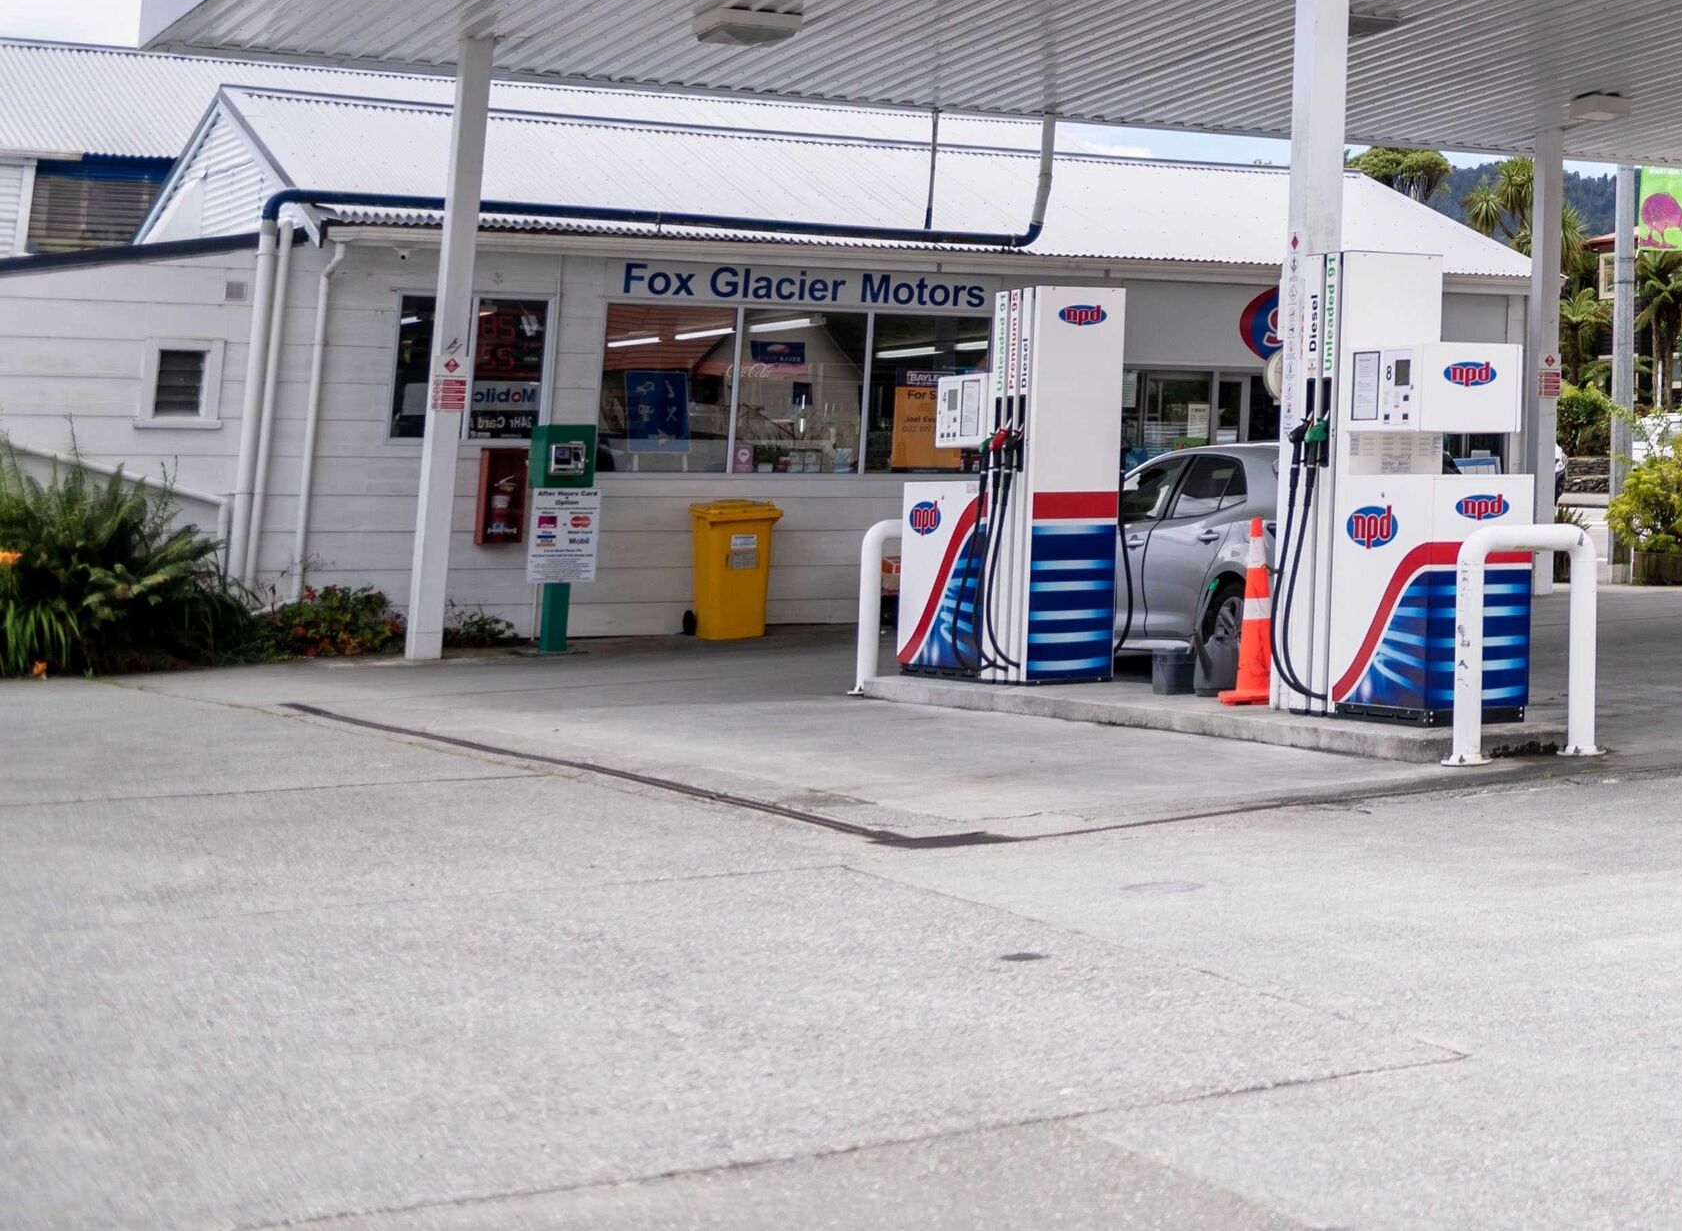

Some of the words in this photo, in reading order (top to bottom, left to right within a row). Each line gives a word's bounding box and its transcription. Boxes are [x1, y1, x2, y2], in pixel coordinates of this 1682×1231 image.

[1328, 257, 1336, 277] 91
[623, 263, 695, 296] Fox
[709, 266, 847, 302] Glacier
[860, 273, 985, 308] Motors
[1065, 305, 1101, 326] npd
[1309, 294, 1318, 352] Diesel
[1325, 284, 1335, 371] Unleaded
[997, 317, 1006, 391] Unleaded
[1008, 317, 1017, 389] Premium
[1386, 365, 1392, 380] 8
[1451, 361, 1490, 387] npd
[907, 390, 926, 400] For
[913, 500, 938, 536] npd
[1462, 493, 1503, 521] npd
[1352, 505, 1392, 549] npd
